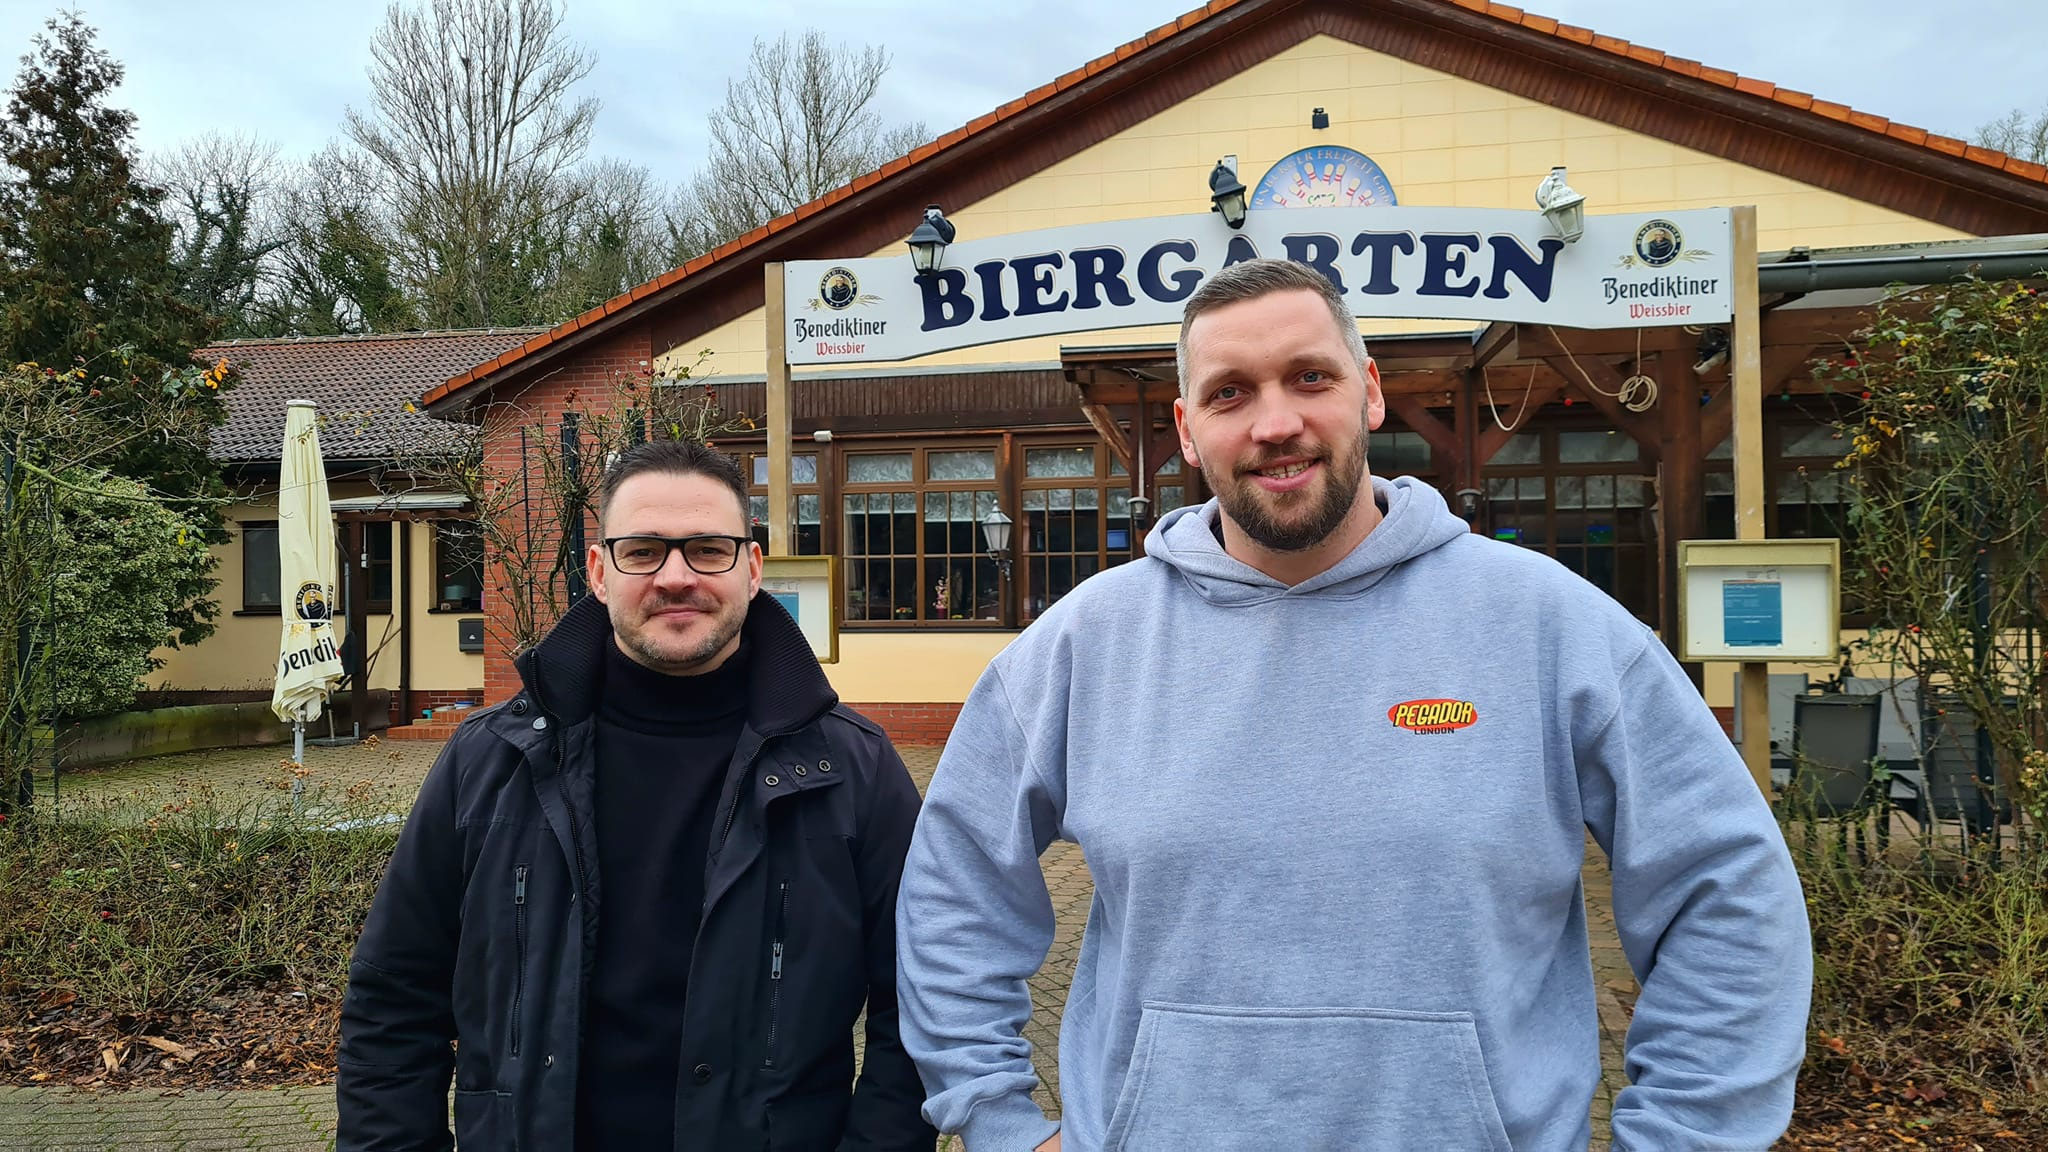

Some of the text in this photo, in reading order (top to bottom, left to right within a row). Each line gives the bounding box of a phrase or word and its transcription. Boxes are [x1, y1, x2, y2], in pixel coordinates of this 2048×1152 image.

[1601, 276, 1719, 305] Benediktiner
[1629, 303, 1691, 318] Weissbier
[793, 317, 887, 343] Benediktiner
[816, 342, 865, 356] Weissbier
[281, 636, 337, 679] endik
[1393, 701, 1474, 727] PEGADOR
[1414, 727, 1455, 735] LONDON
